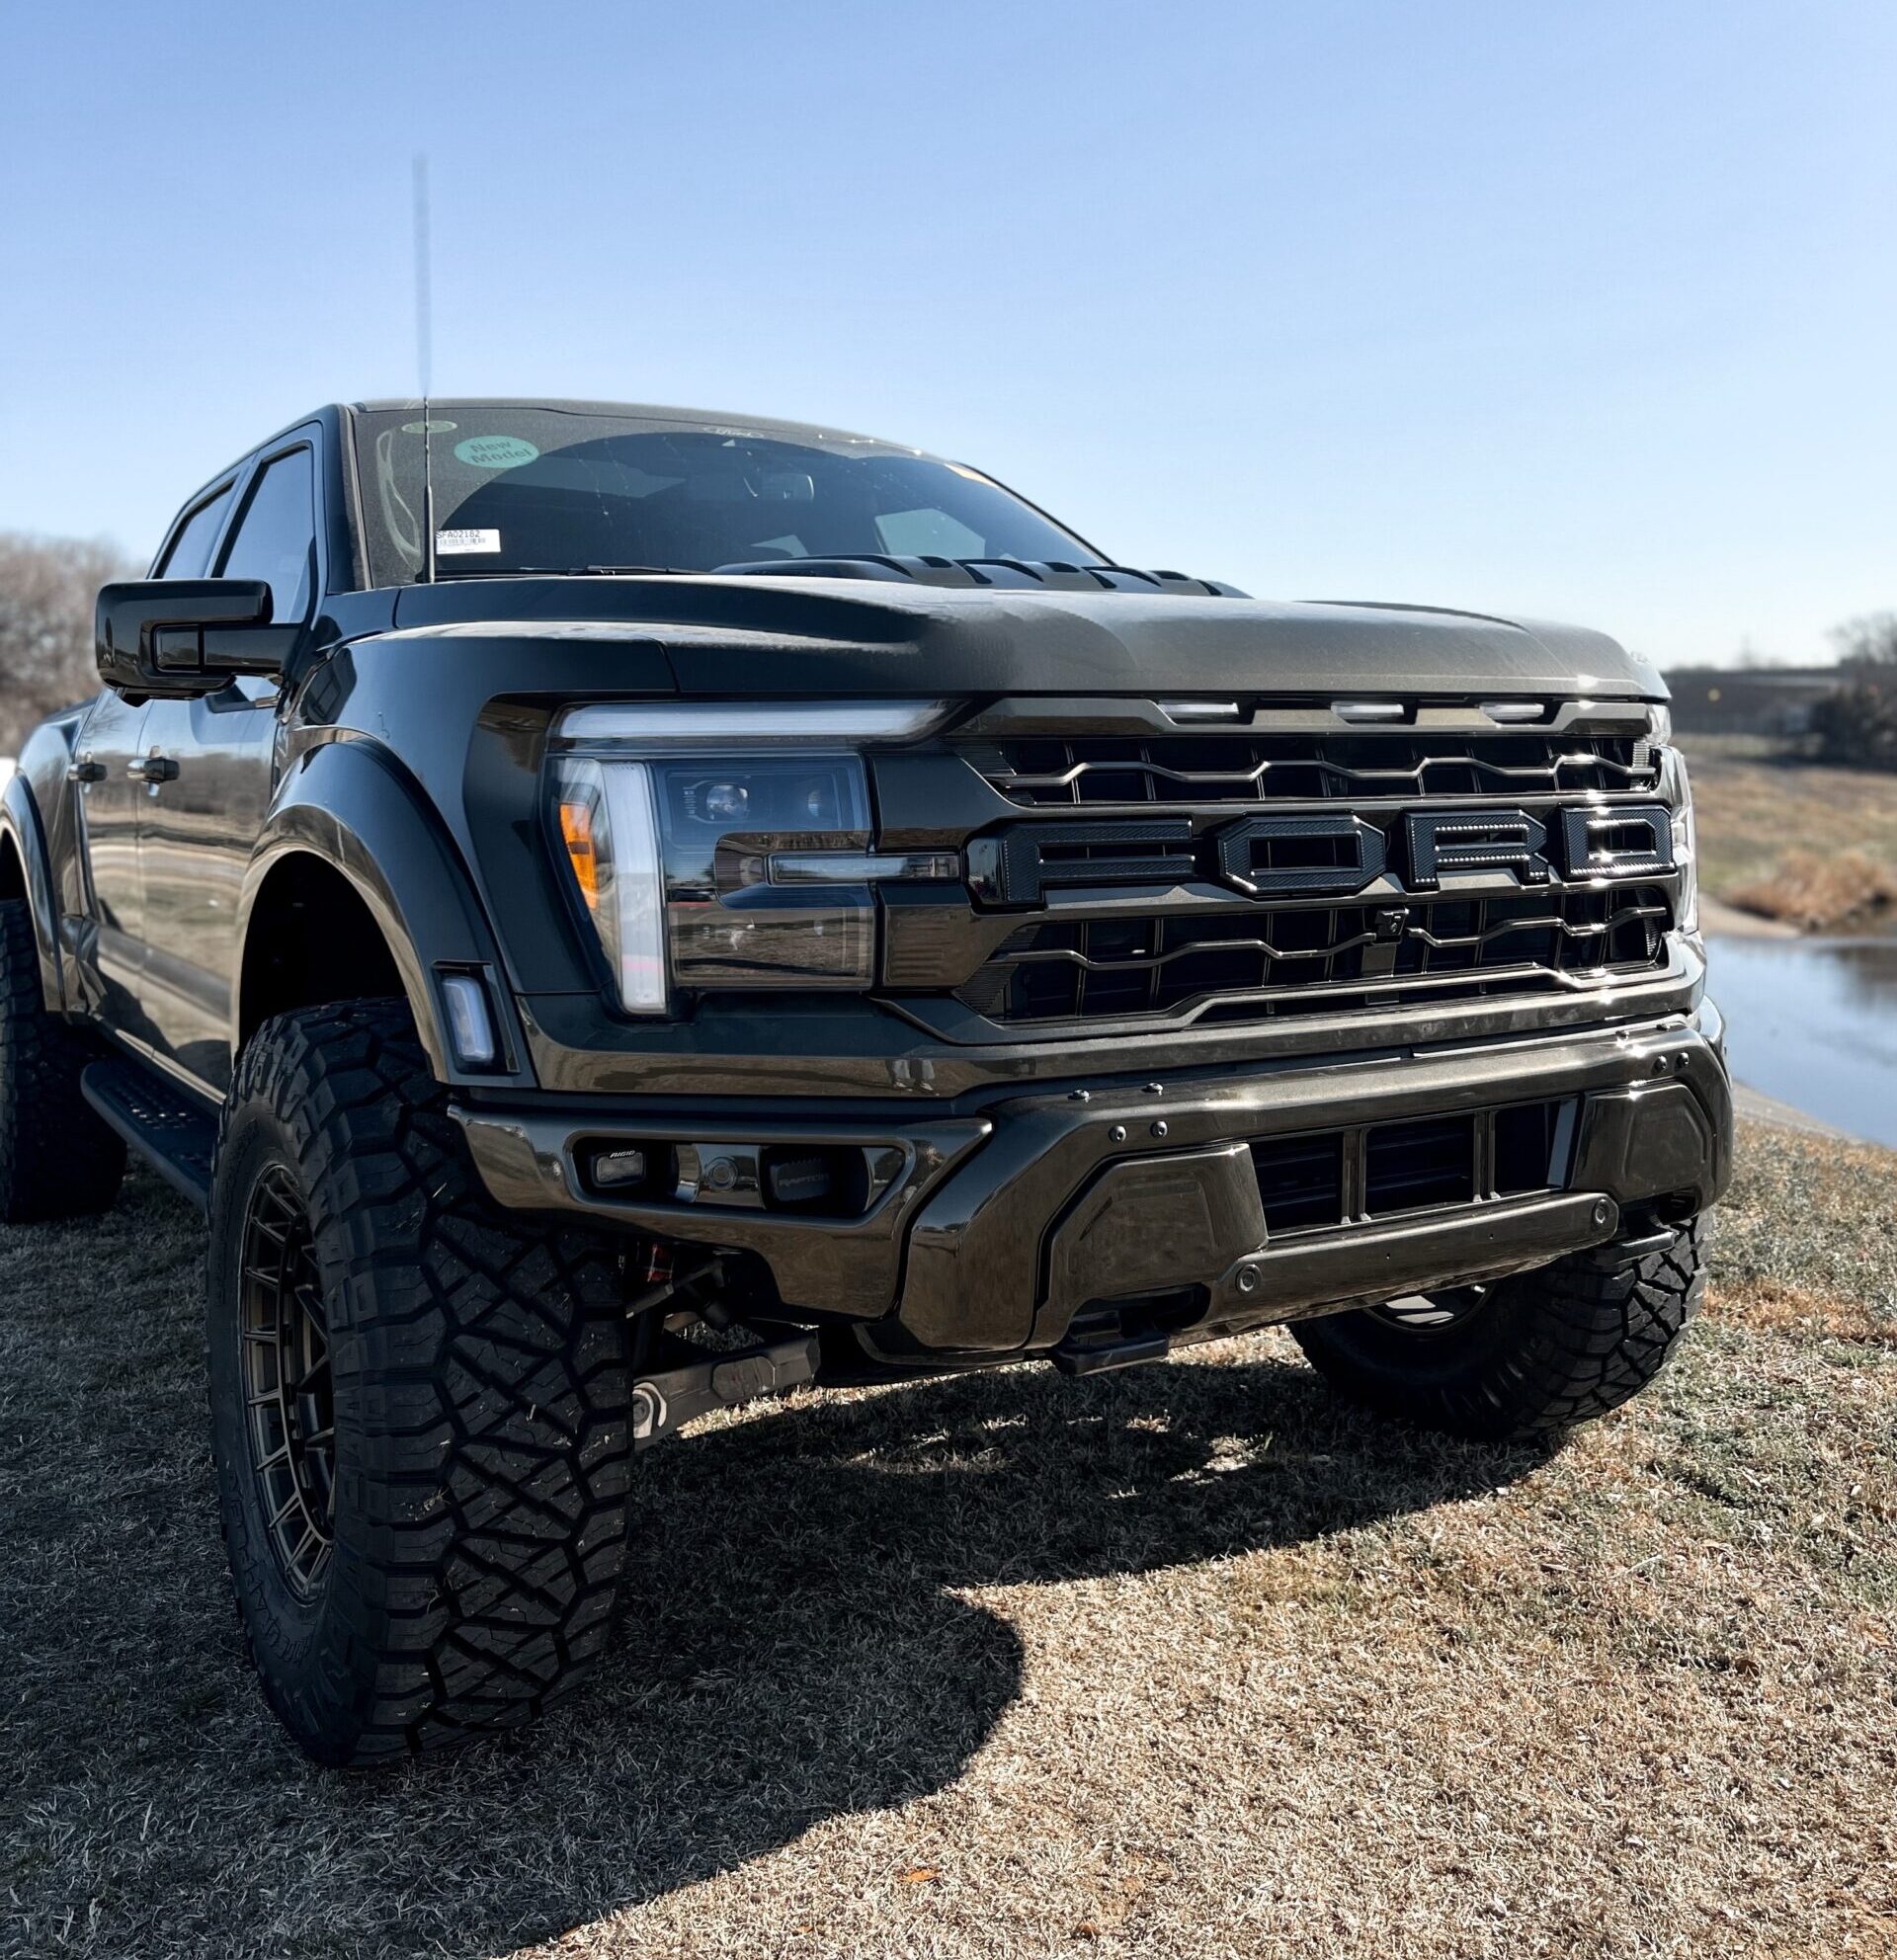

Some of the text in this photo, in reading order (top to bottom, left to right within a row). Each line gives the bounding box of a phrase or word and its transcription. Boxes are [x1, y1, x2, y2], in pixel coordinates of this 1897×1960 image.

[469, 441, 511, 452] New
[470, 449, 533, 463] Model
[435, 530, 480, 538] SFA02182
[968, 803, 1676, 908] FORD
